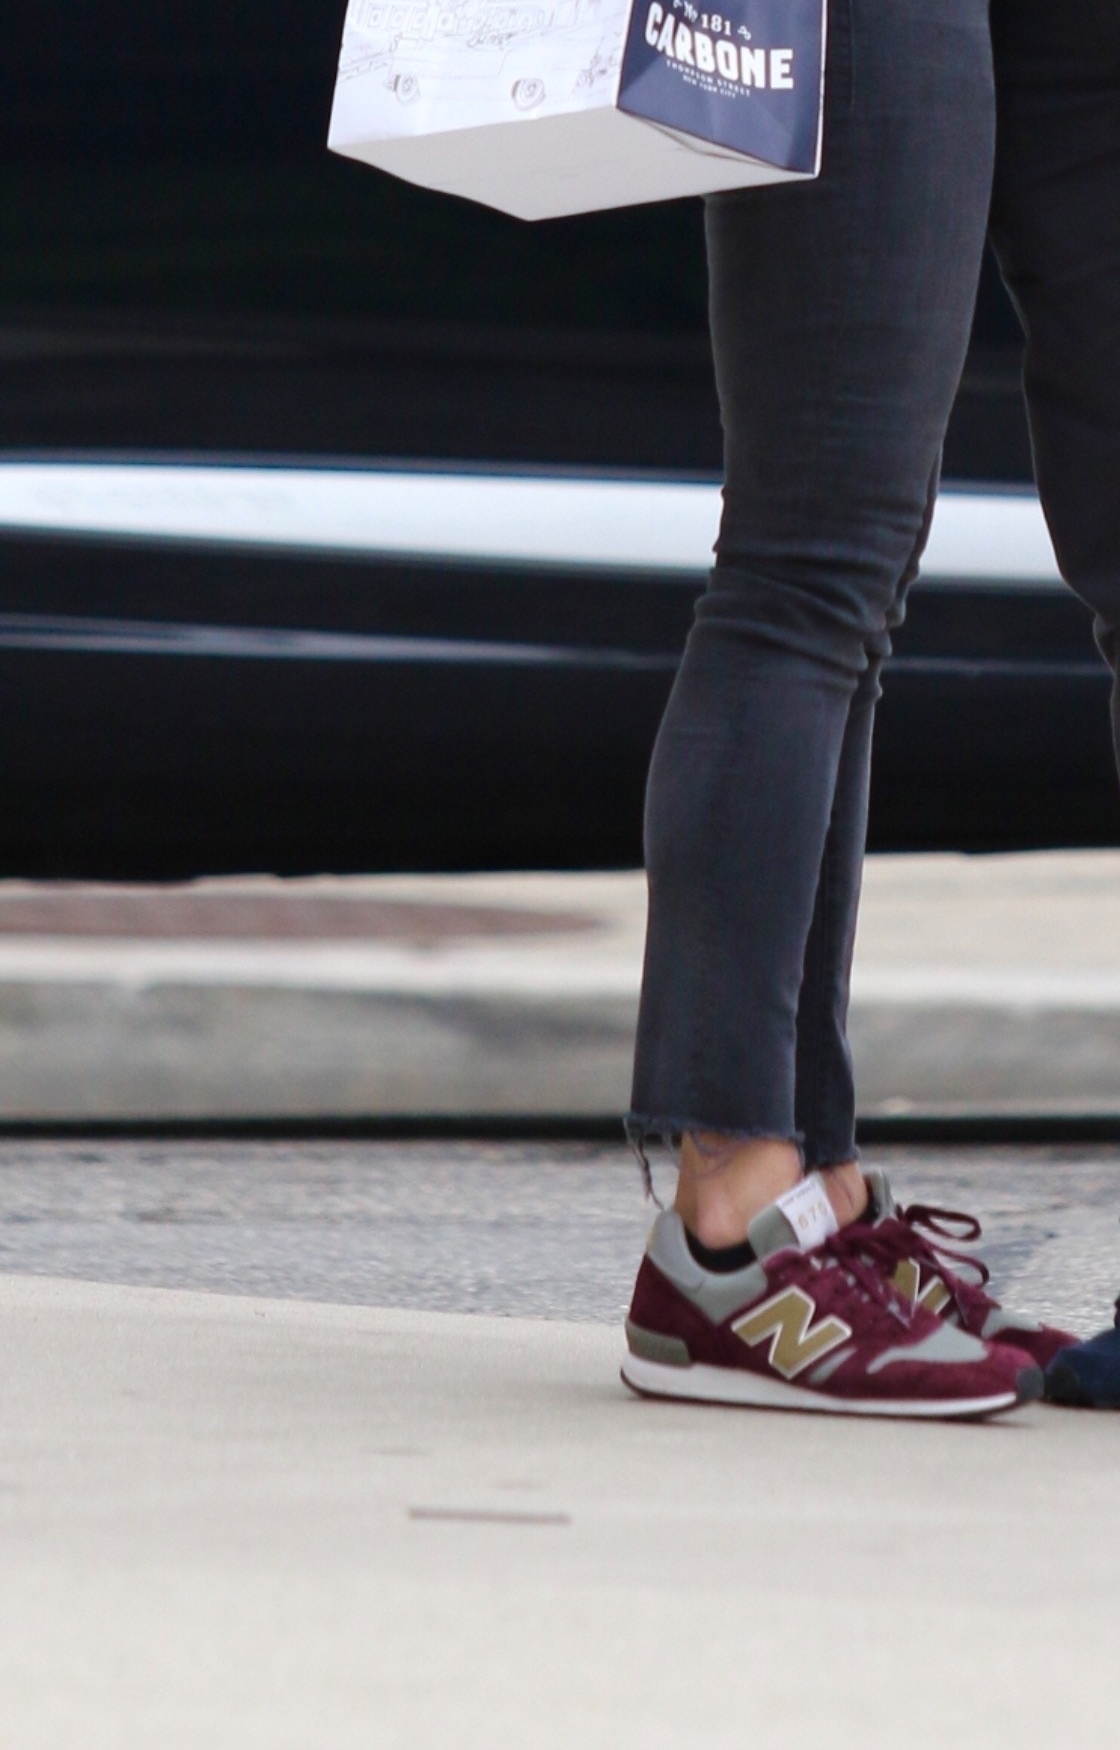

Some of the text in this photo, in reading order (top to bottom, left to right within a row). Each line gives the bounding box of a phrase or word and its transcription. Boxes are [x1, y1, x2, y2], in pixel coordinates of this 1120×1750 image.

[701, 13, 732, 36] 181
[645, 1, 794, 90] CARBONE
[716, 78, 751, 98] STREET
[719, 87, 737, 99] CITY
[731, 1284, 852, 1380] N
